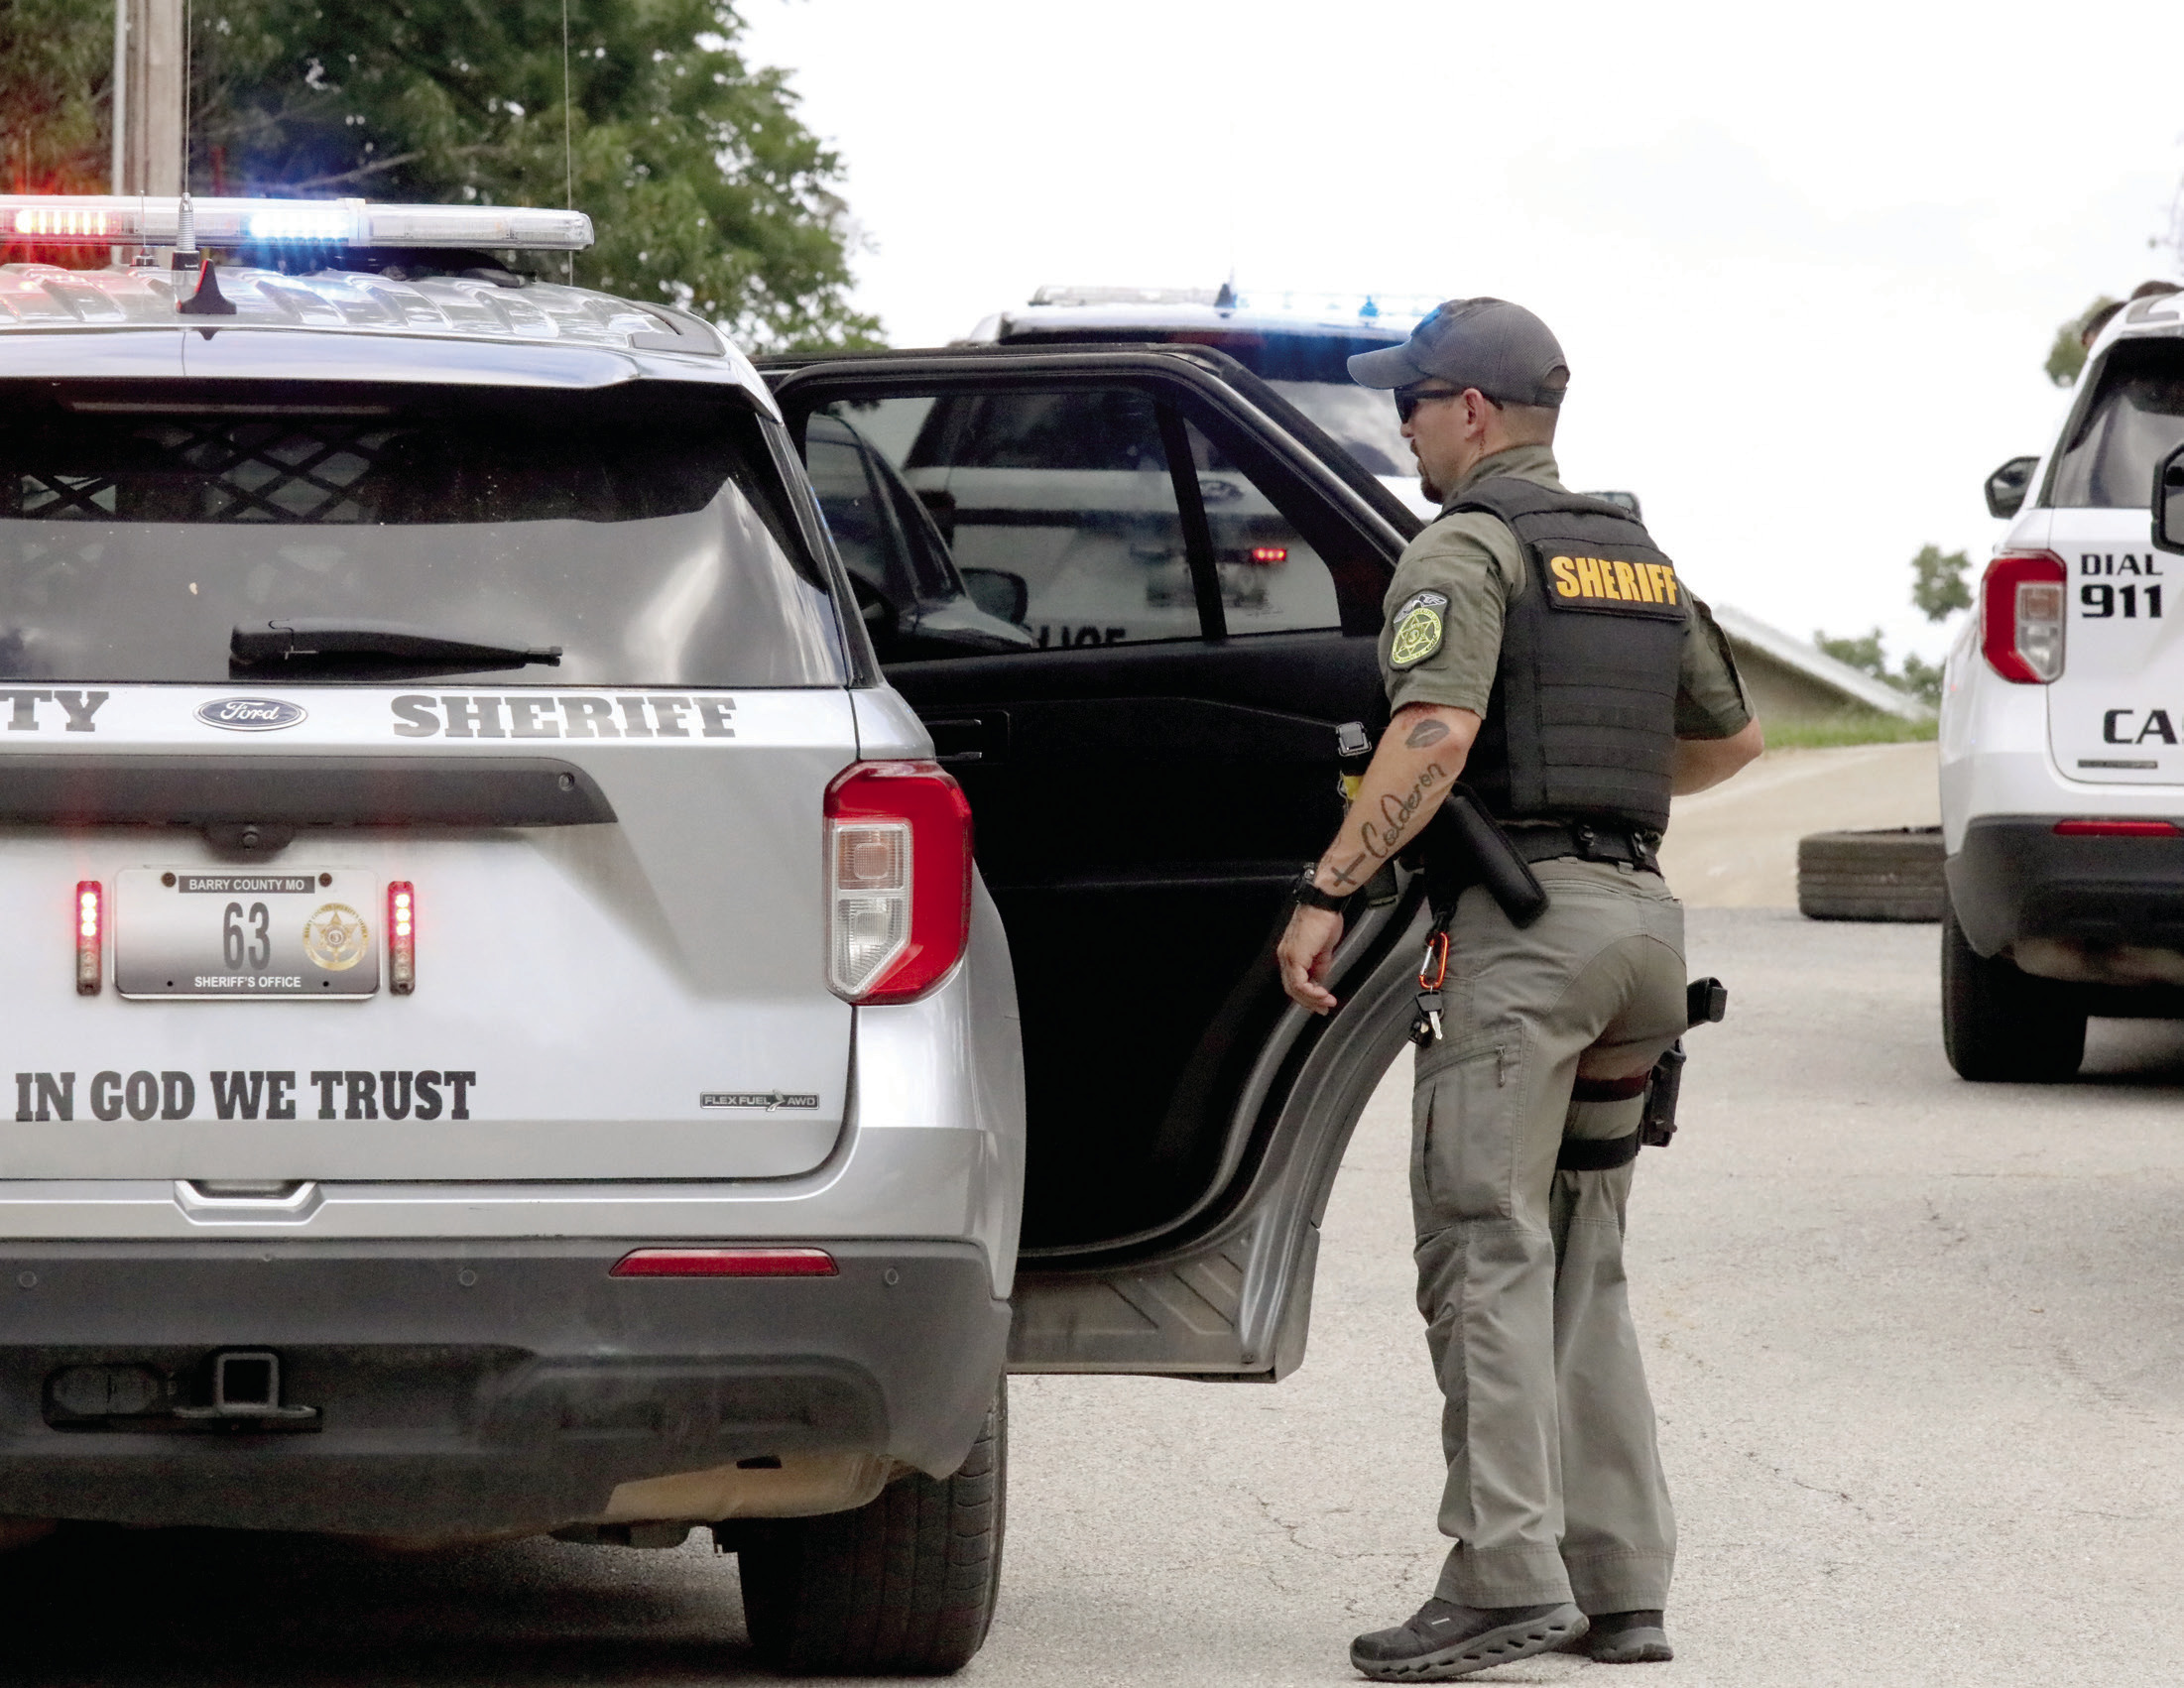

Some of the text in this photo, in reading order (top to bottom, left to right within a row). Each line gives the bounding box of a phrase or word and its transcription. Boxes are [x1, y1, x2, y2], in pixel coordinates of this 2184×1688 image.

[1550, 555, 1678, 606] SHERIFF
[2080, 554, 2163, 576] DIAL
[2080, 583, 2163, 619] 911
[0, 689, 737, 738] TY SHERIFF
[220, 700, 279, 722] Ford
[2103, 709, 2184, 745] CA
[188, 879, 304, 891] BARRY COUNTY MO
[223, 902, 271, 971] 63
[194, 976, 302, 988] SHERIFF'S OFFICE
[15, 1070, 476, 1123] IN GOD WE TRUST
[704, 1096, 815, 1106] FLEX FUEL AWD
